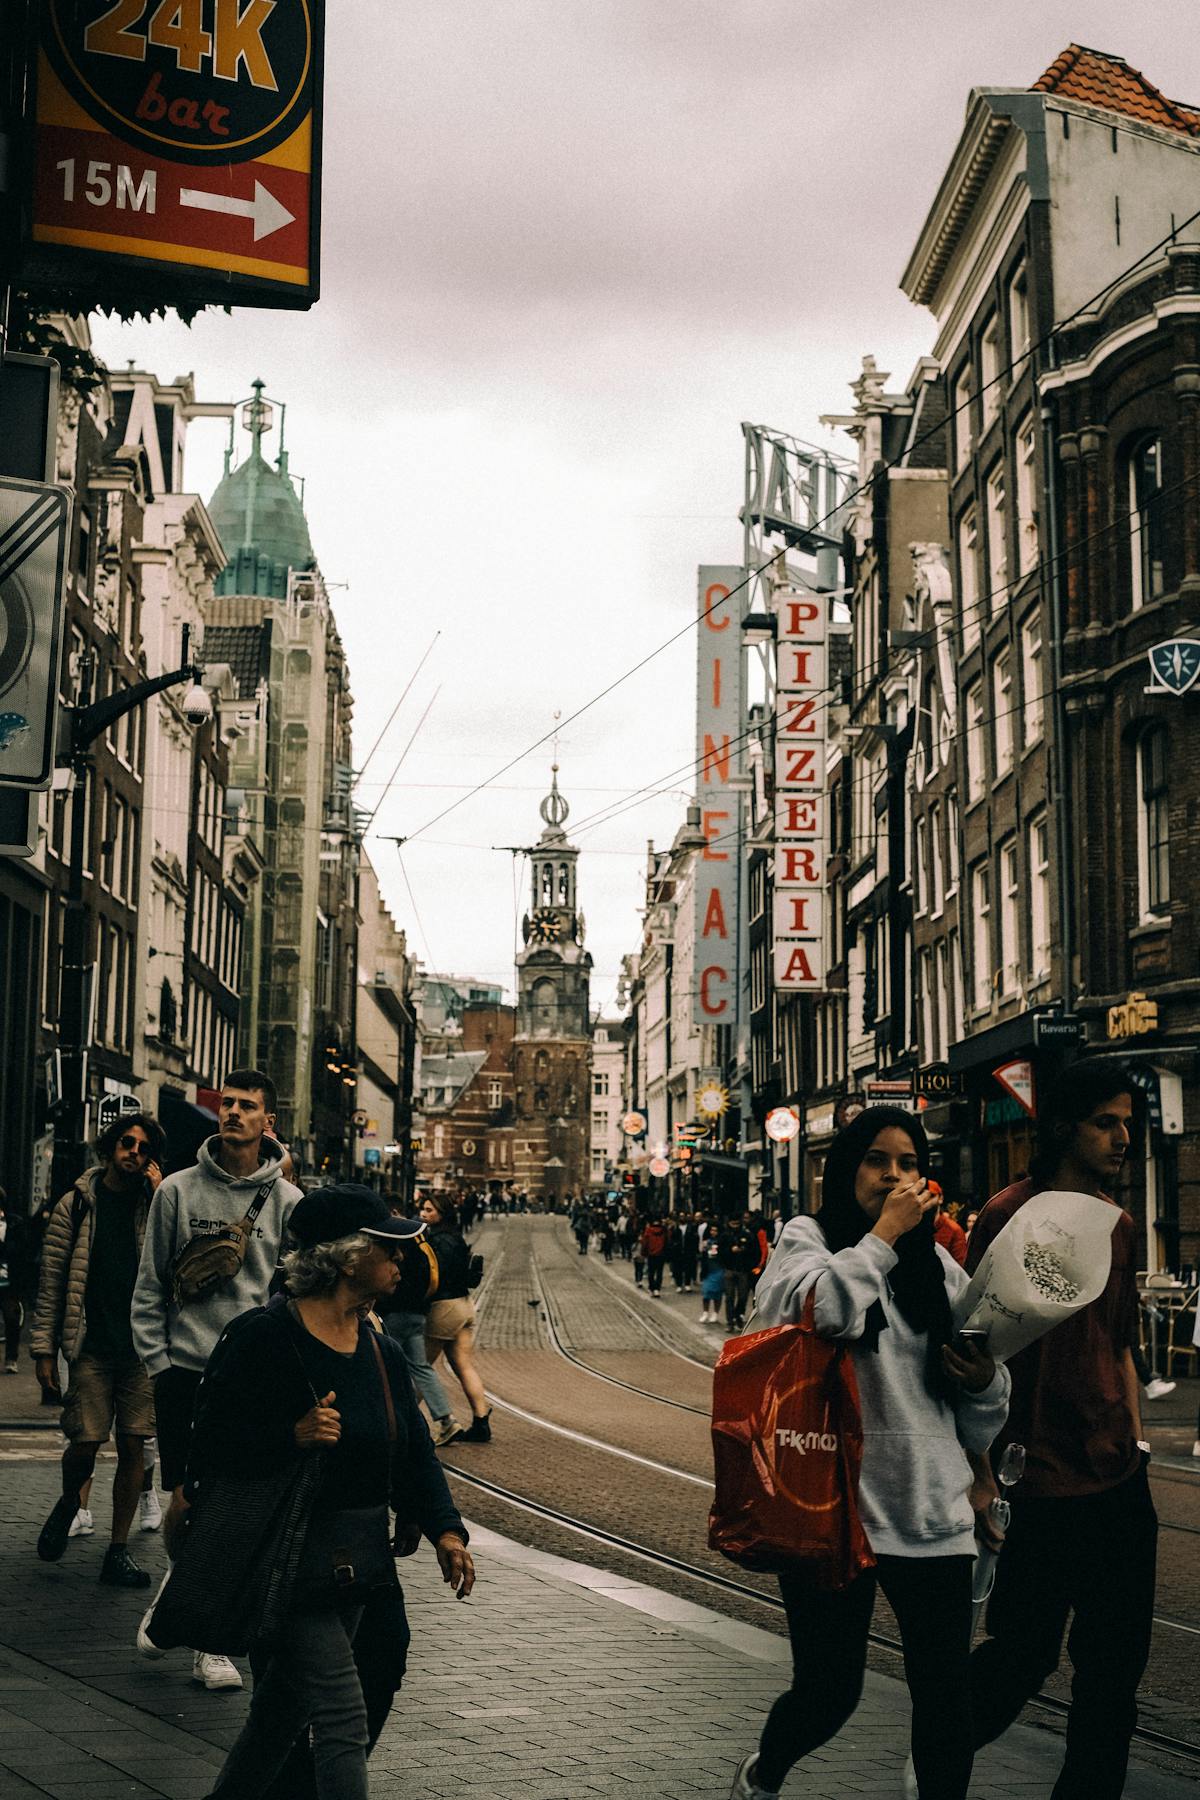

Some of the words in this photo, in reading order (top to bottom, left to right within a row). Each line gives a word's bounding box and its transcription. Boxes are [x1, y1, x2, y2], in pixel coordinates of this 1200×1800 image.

[84, 0, 280, 93] 24K
[135, 72, 232, 136] bar
[56, 157, 158, 215] 15M
[700, 583, 731, 1017] CINEAC
[780, 603, 820, 981] PIZZERIA
[1040, 1023, 1078, 1034] Bavaria
